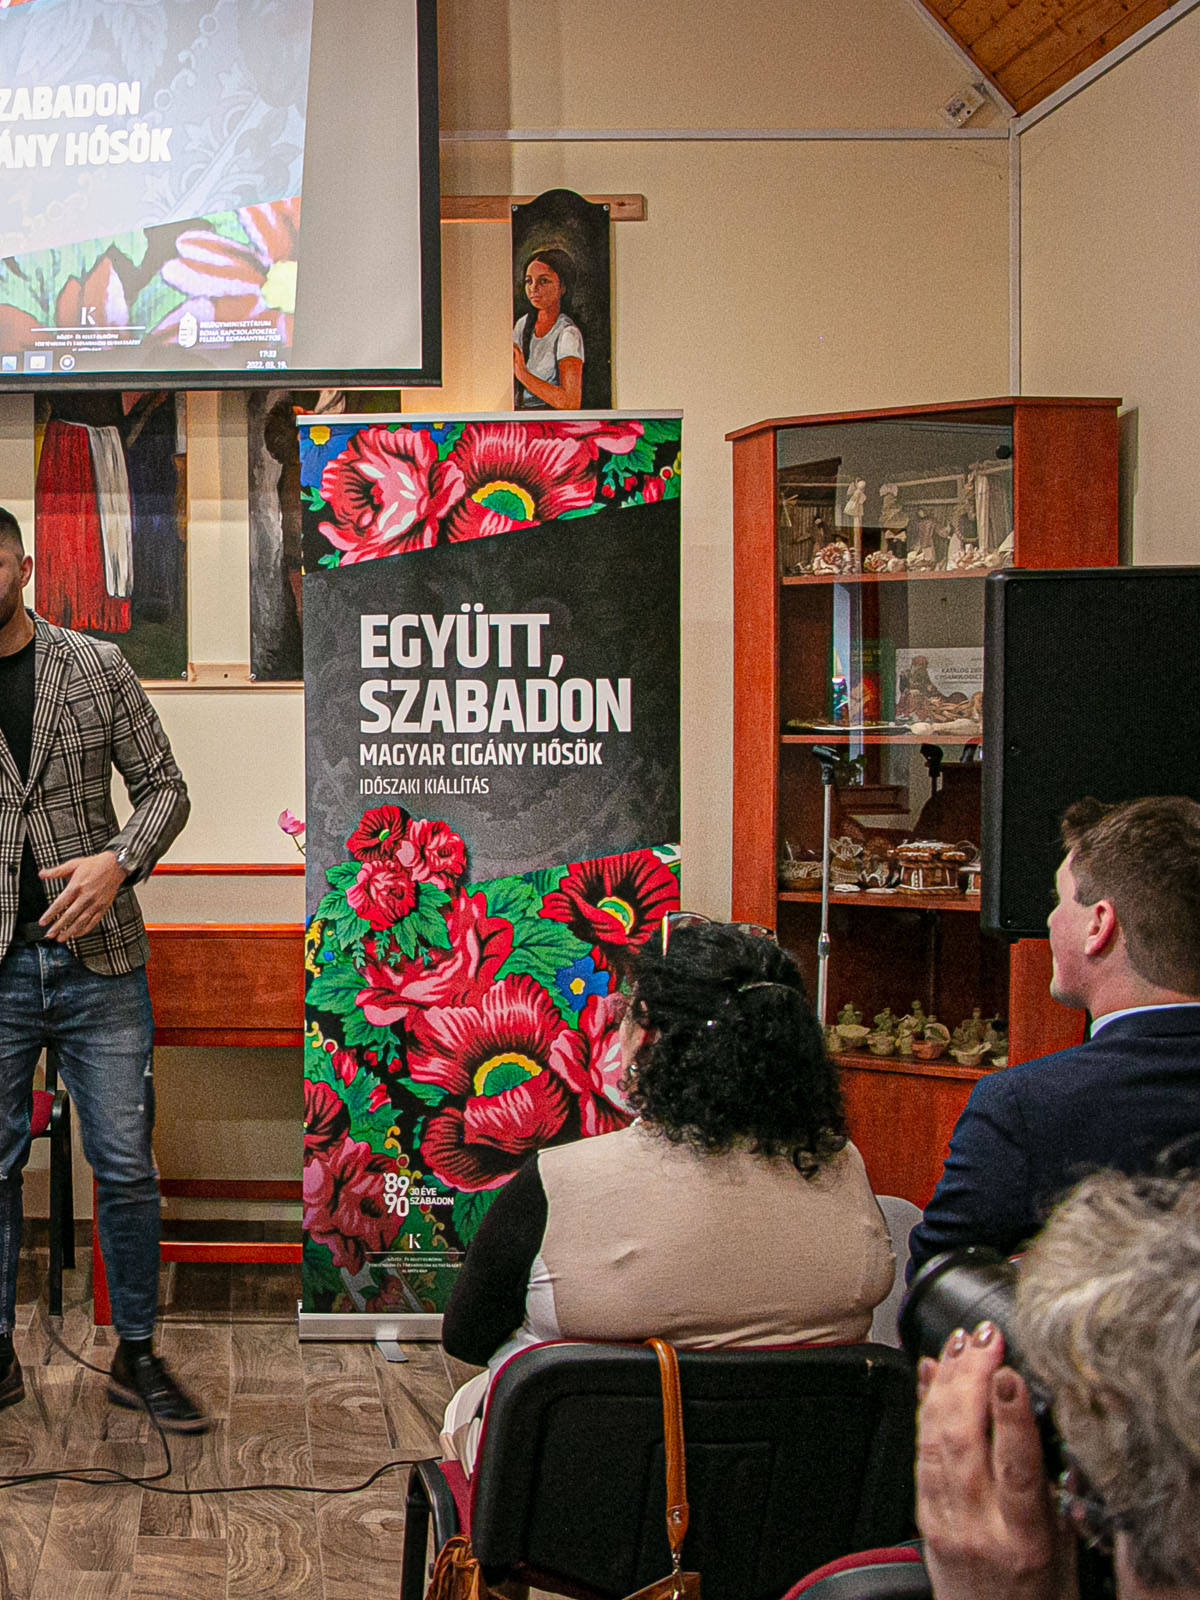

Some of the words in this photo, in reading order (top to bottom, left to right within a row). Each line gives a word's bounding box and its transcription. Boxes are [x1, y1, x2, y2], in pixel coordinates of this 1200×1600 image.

[64, 122, 173, 166] HŐSÖK
[360, 602, 564, 677] EGYÜTT,
[359, 678, 632, 733] SZABADON
[359, 743, 446, 766] MAGYAR
[451, 739, 527, 766] CIGÁNY
[533, 738, 603, 765] HŐSÖK
[359, 775, 421, 795] IDŐSZAKI
[424, 775, 490, 794] KIÁLLÍTÁS
[409, 1187, 420, 1196] 30
[420, 1185, 438, 1196] ÉVE
[409, 1196, 454, 1205] SZABADON
[408, 1233, 422, 1249] K
